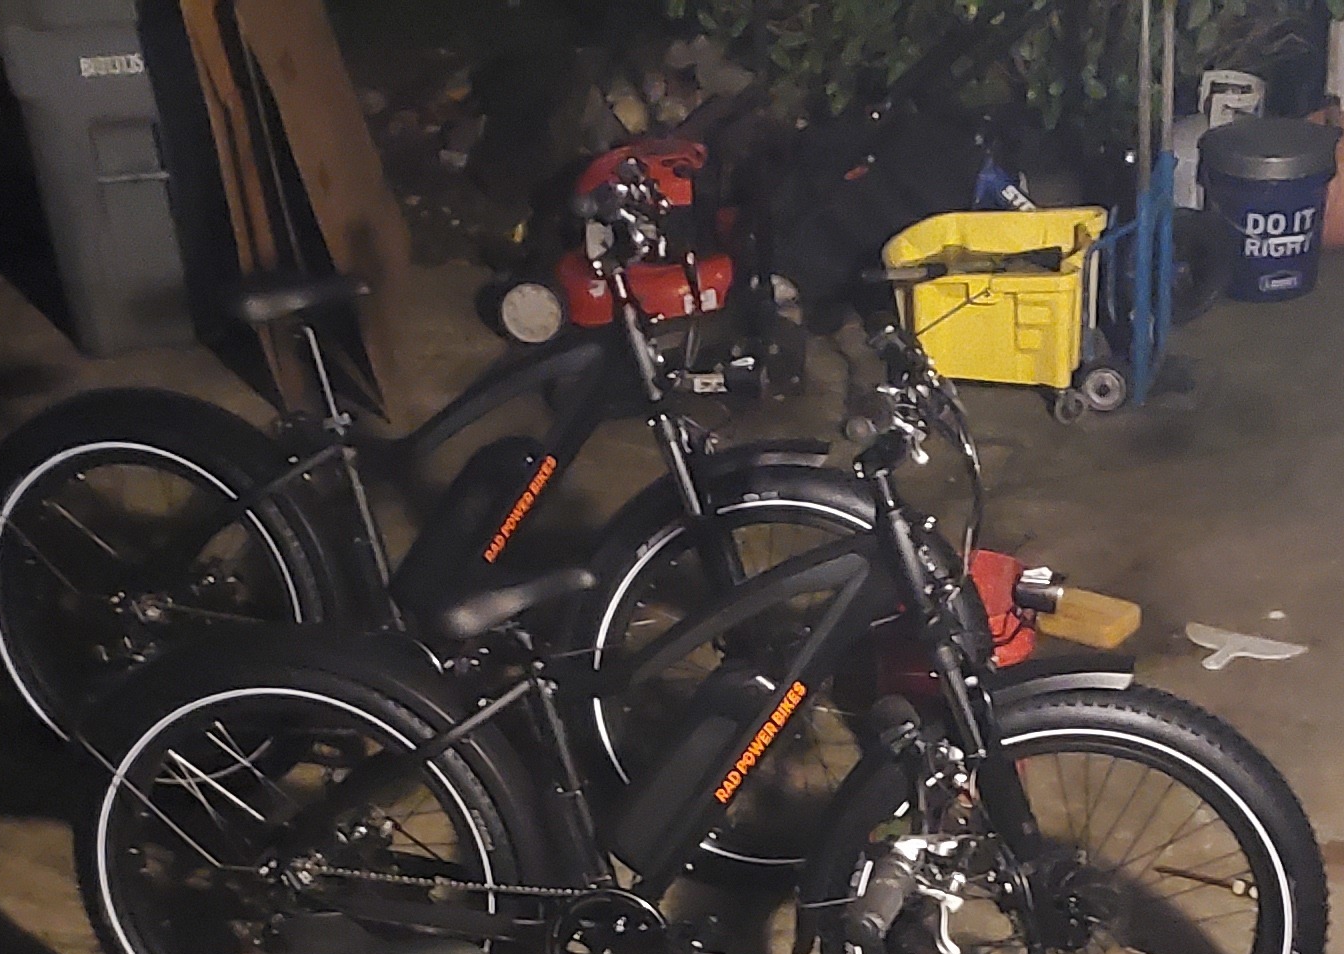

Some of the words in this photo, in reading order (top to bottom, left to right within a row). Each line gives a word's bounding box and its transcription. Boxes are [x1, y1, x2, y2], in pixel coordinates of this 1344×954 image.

[1244, 231, 1313, 258] RIGHT
[1247, 213, 1287, 235] DO
[1293, 207, 1316, 232] IT
[484, 534, 505, 562] RAD
[501, 492, 535, 538] POWER
[528, 455, 557, 495] BIKES
[714, 770, 742, 804] RAD
[736, 721, 779, 775] POWER
[770, 681, 807, 727] BIKES
